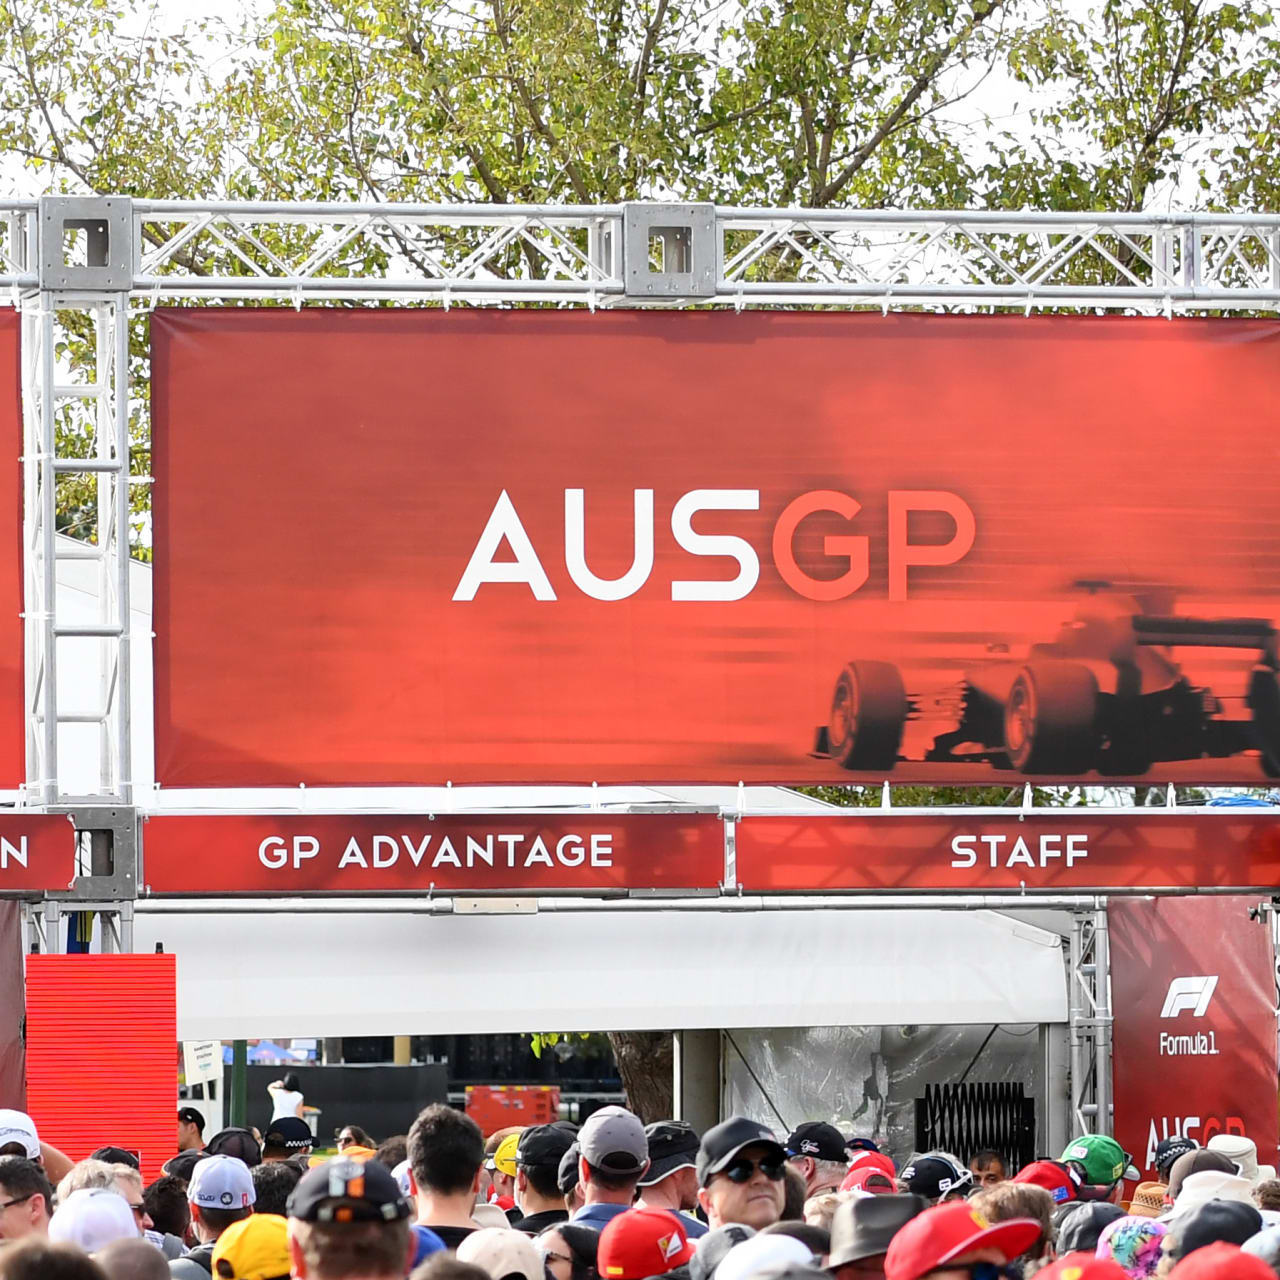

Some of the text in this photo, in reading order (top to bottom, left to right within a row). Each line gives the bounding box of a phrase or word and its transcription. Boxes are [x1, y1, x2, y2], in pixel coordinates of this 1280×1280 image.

[452, 488, 976, 602] AUSGP
[259, 835, 614, 870] GP ADVANTAGE
[952, 835, 1089, 869] STAFF
